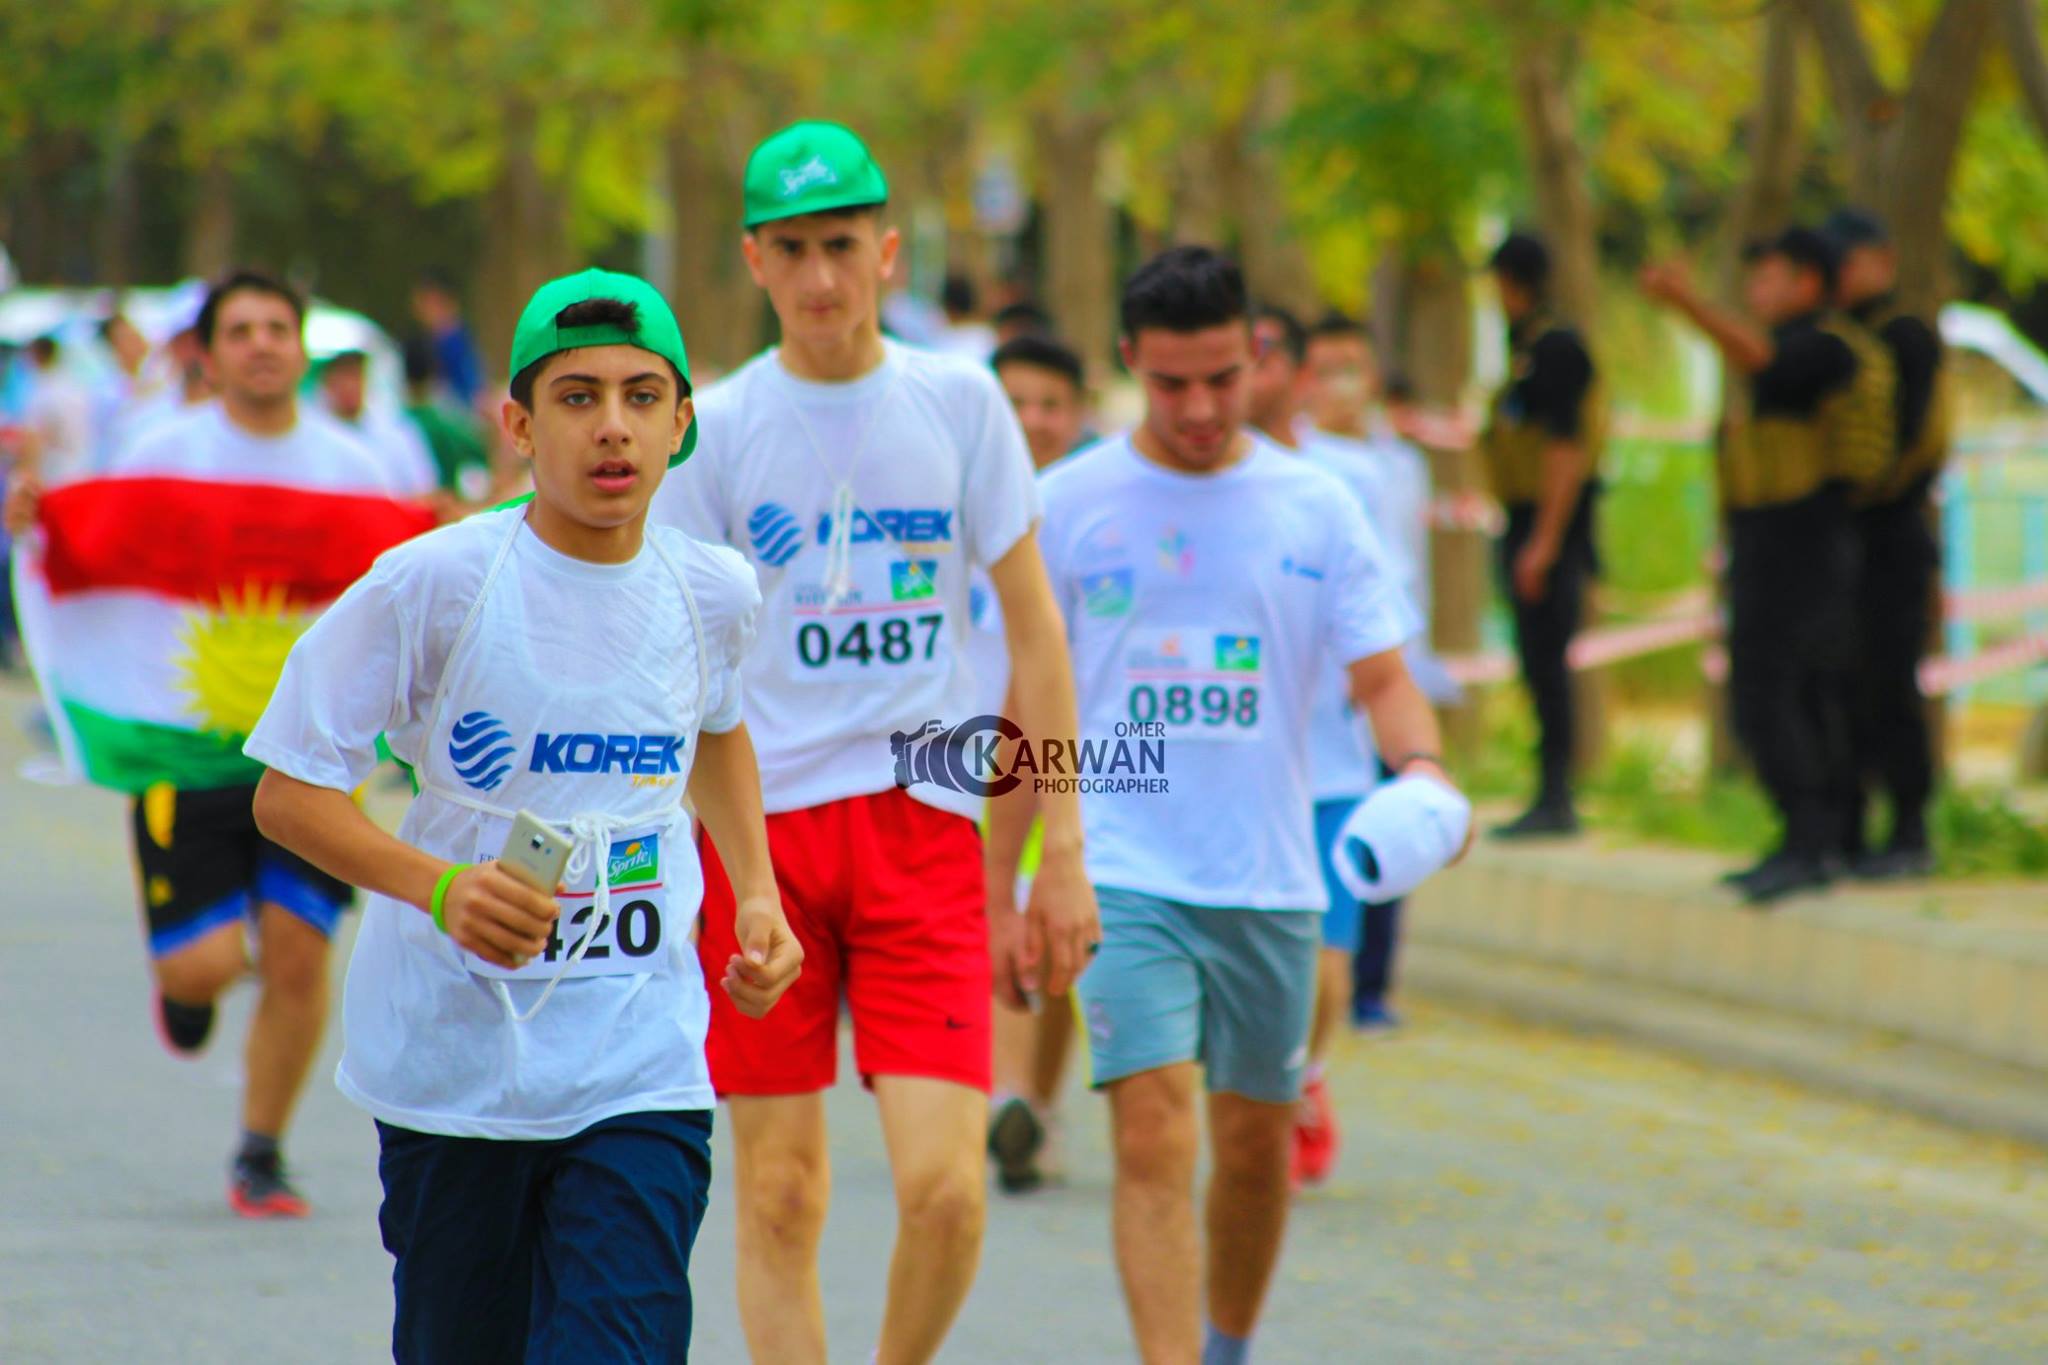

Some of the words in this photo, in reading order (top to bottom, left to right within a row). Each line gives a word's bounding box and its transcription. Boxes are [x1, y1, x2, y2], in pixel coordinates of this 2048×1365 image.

[797, 613, 943, 669] 0487
[1128, 684, 1259, 727] 0898
[529, 733, 685, 774] KOREK
[608, 847, 649, 877] Sprite
